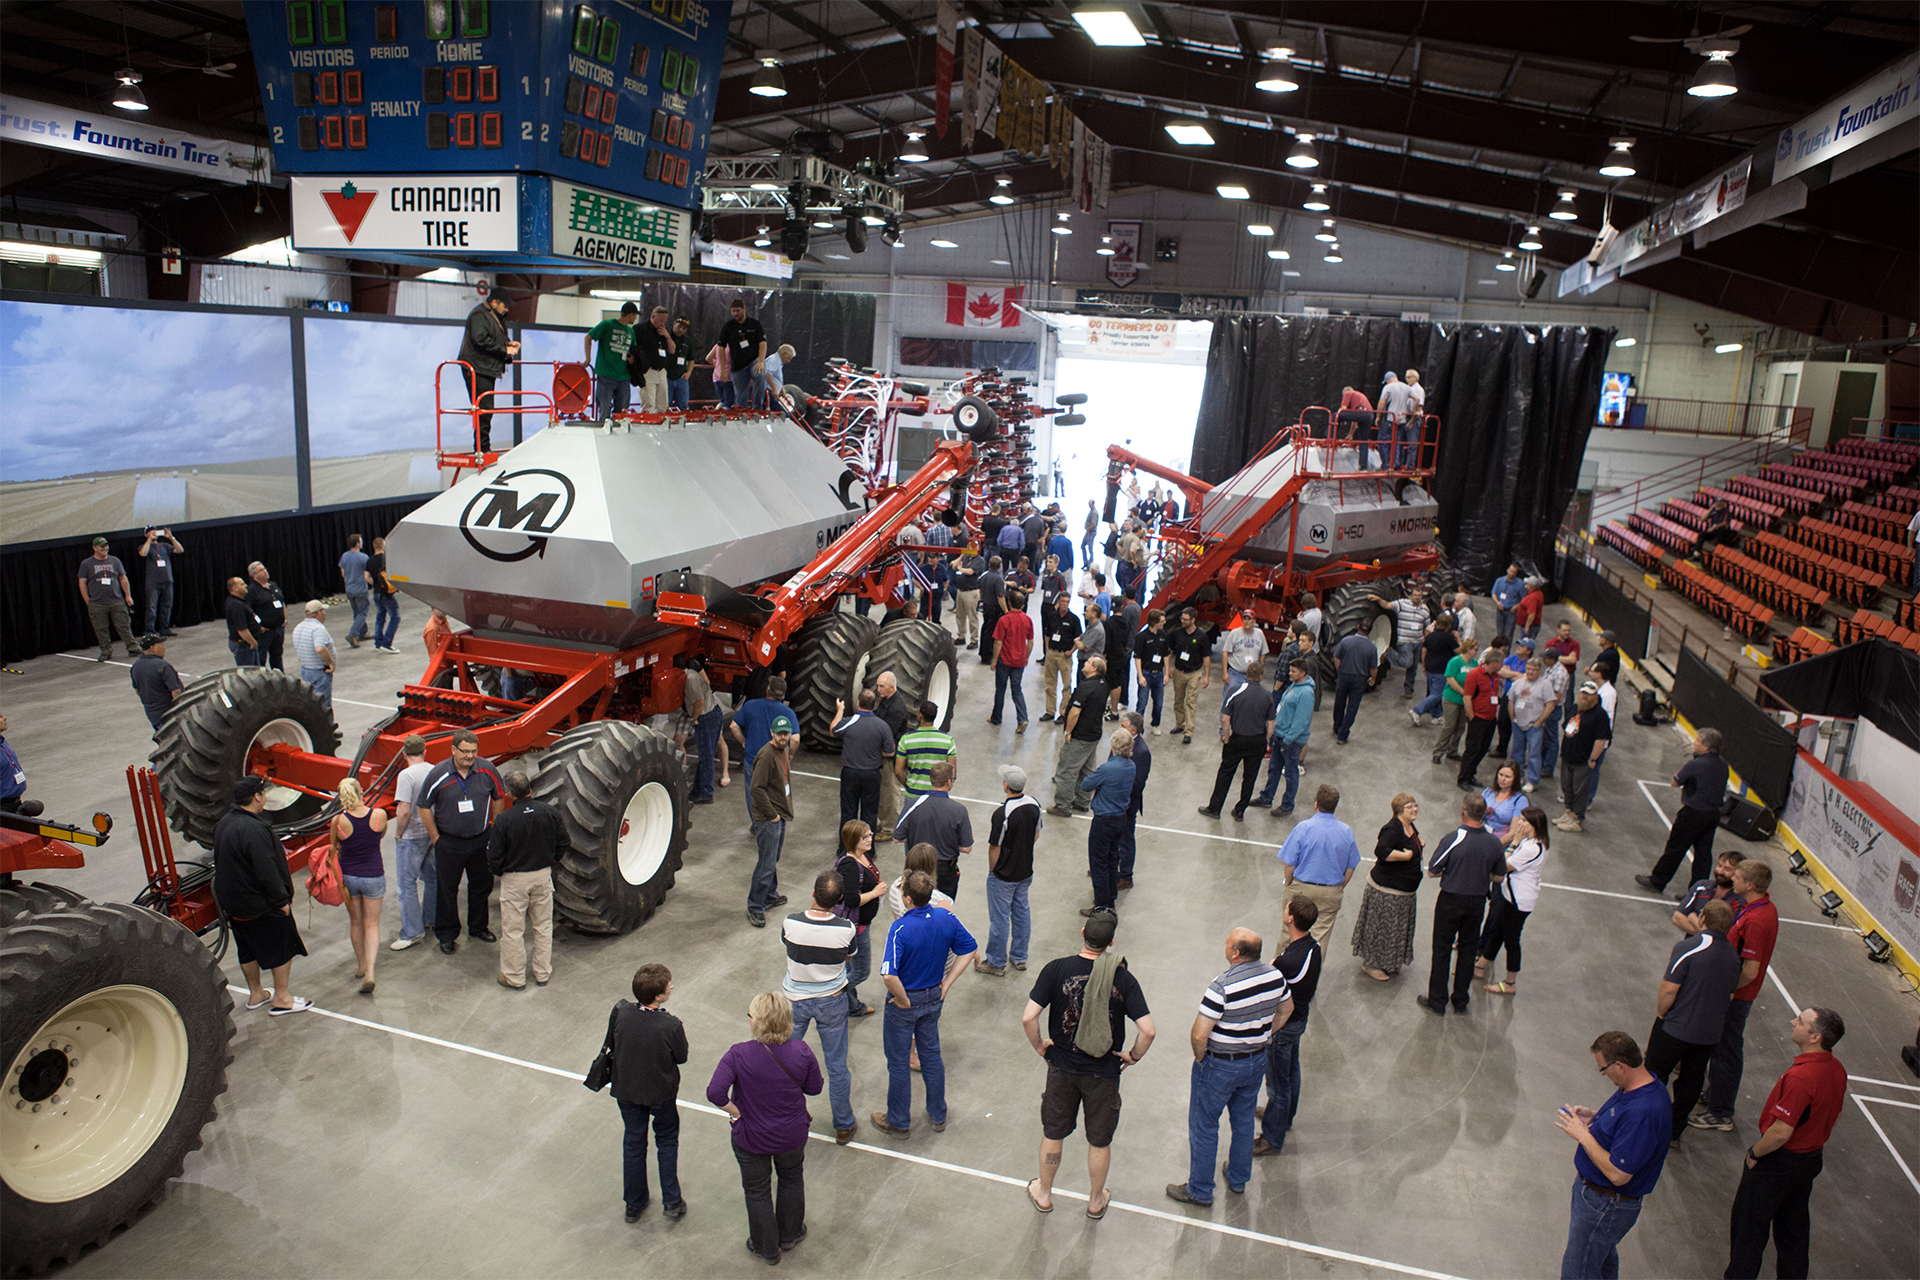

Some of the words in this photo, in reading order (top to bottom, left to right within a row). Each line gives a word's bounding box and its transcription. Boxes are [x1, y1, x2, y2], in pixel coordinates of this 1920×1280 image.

[687, 0, 710, 28] SEC
[289, 49, 354, 68] VISITORS
[370, 46, 410, 59] PERIOD
[436, 43, 483, 62] HOME
[568, 54, 614, 88] VISITORS
[266, 82, 274, 100] 1
[521, 76, 530, 95] 1
[544, 78, 550, 96] 1
[624, 77, 648, 96] PERIOD
[370, 100, 420, 117] PENALTY
[662, 92, 688, 116] HOME
[521, 122, 533, 140] 2
[1796, 125, 1832, 161] Trust.
[1834, 83, 1910, 142] Fountain
[273, 126, 284, 144] 2
[540, 124, 550, 142] 2
[614, 124, 646, 148] PENALTY
[72, 120, 178, 159] Fountain
[180, 140, 219, 167] Tire
[391, 187, 500, 212] CANADIAN
[570, 188, 678, 249] FARRELL
[422, 221, 469, 246] TIRE
[572, 236, 648, 266] AGENCIES
[650, 250, 676, 271] LTD.
[1088, 319, 1102, 329] GO
[1105, 320, 1153, 332] TERRIERS
[1154, 323, 1168, 332] GO
[1337, 524, 1364, 541] 9450
[1397, 516, 1437, 533] MORRIS
[1842, 800, 1873, 838] ELECTRIC
[1897, 873, 1915, 898] RME
